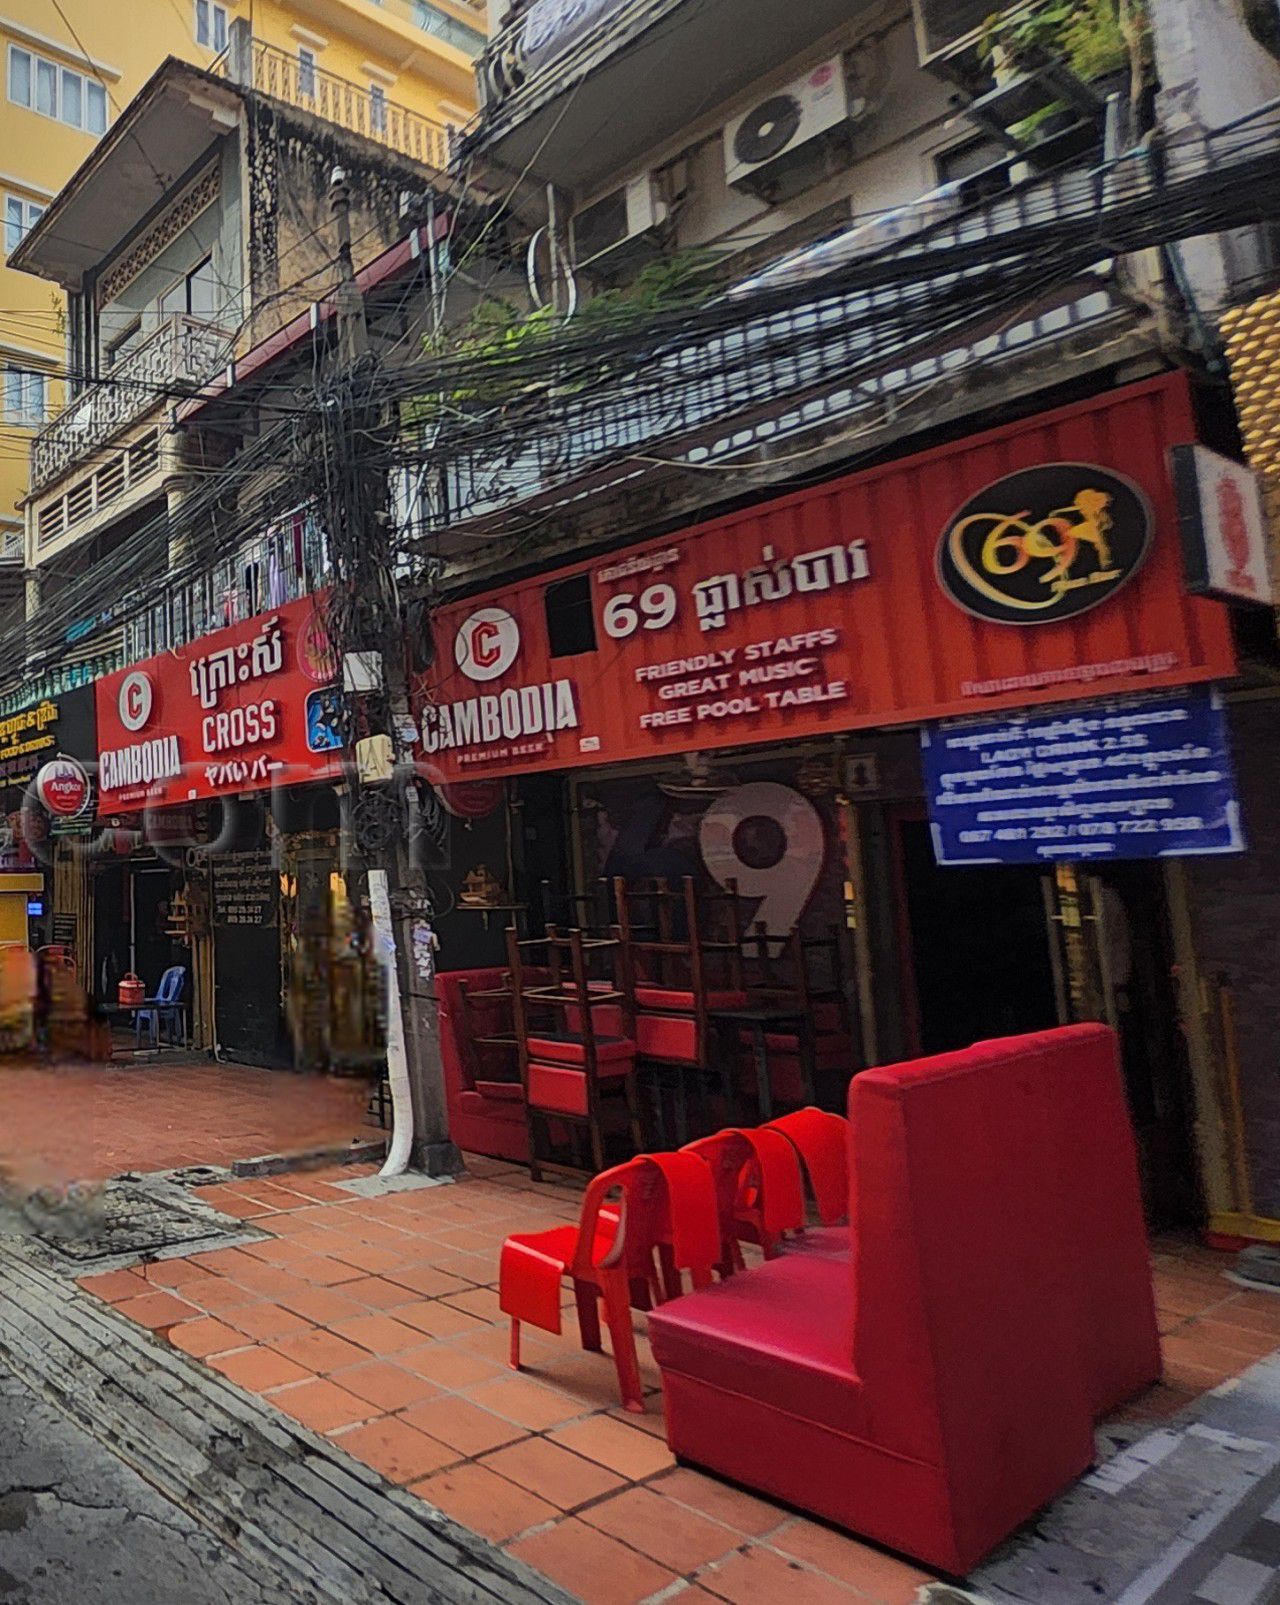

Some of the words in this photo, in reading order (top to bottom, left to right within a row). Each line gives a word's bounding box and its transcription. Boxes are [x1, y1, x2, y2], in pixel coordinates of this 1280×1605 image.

[603, 583, 678, 640] 69
[634, 648, 737, 683] FRIENDLY
[745, 627, 839, 661] STAFFS
[658, 672, 732, 700] GREAT
[738, 656, 820, 688] MUSIC
[201, 700, 277, 754] CROSS
[421, 678, 579, 754] CAMBODIA
[638, 705, 693, 729] FREE
[697, 696, 761, 721] POOL
[764, 680, 849, 709] TABLE
[98, 734, 182, 793] CAMBODIA
[205, 754, 284, 787] ヤバいバー
[456, 748, 509, 765] PREMIUM
[50, 781, 81, 795] Angkor
